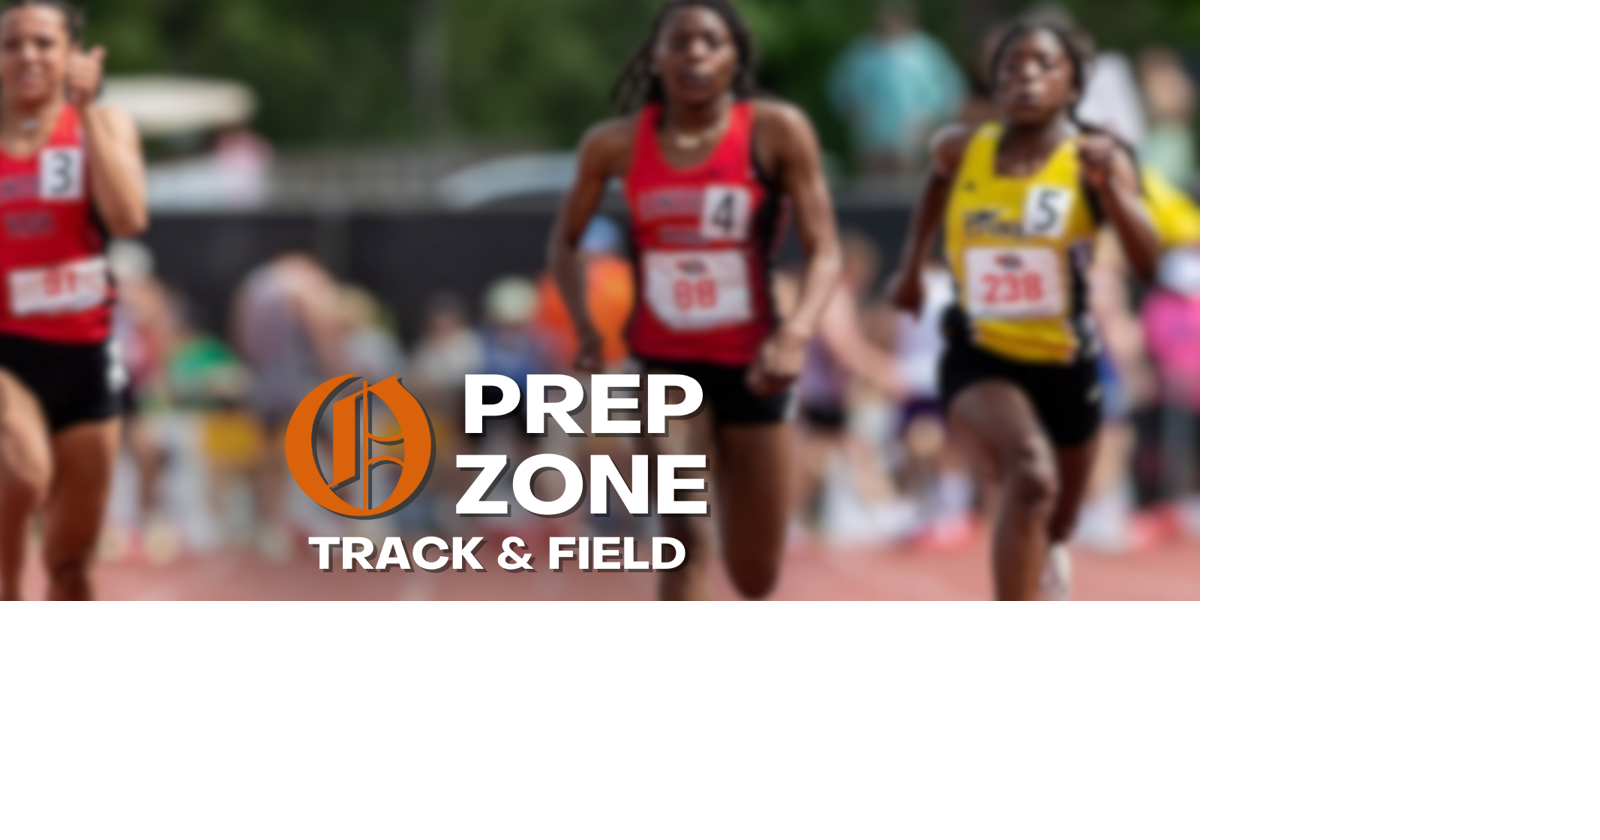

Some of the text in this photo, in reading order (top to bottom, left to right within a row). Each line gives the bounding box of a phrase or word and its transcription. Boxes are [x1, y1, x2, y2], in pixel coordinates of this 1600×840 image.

[50, 151, 74, 194] 3
[710, 191, 735, 234] 4
[1034, 188, 1061, 232] 5
[981, 271, 1044, 305] 238
